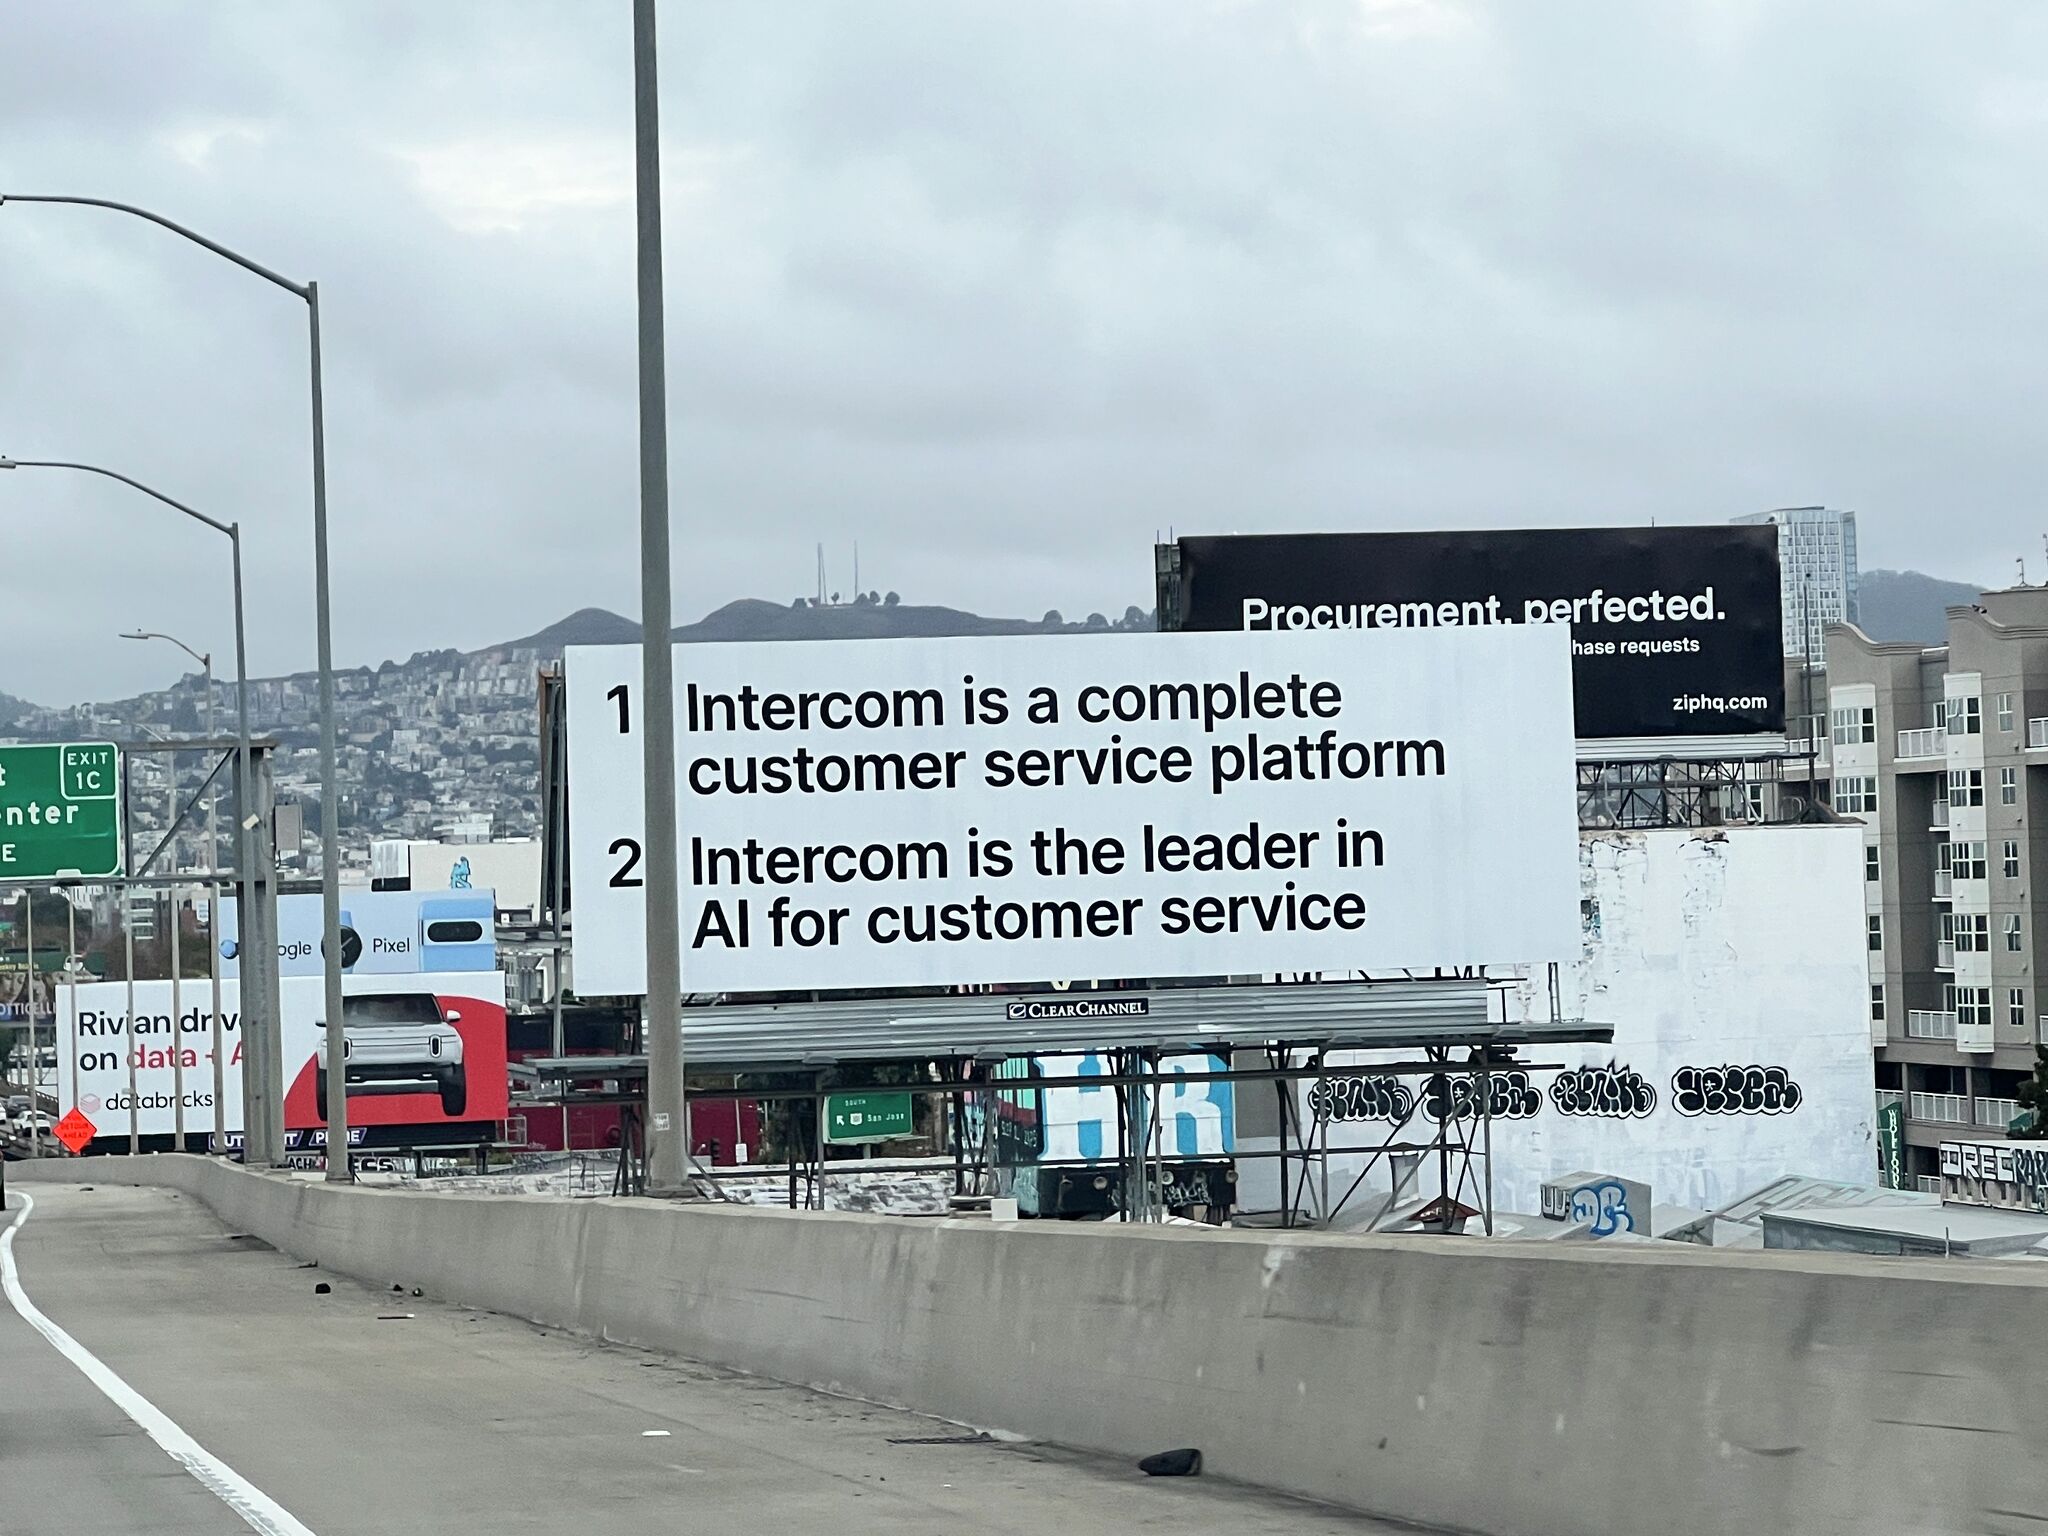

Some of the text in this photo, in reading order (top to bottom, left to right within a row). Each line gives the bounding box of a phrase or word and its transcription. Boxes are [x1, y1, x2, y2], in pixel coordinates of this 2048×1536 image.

[1524, 587, 1726, 624] perfected.
[1572, 637, 1700, 657] hase requests
[608, 671, 1342, 734] 1 Intercom is a complete
[1673, 693, 1768, 714] ziphq.com
[67, 752, 108, 765] EXIT
[688, 729, 1445, 796] customer service platform
[76, 771, 100, 789] 1C
[0, 801, 79, 825] nter
[608, 817, 1384, 888] 2 Intercom is the leader in
[691, 880, 1366, 949] AI for customer service
[278, 938, 410, 959] ogle Pixel
[80, 1051, 118, 1072] on
[127, 1043, 197, 1070] data
[106, 1089, 213, 1111] databrcks
[867, 1113, 882, 1122] San
